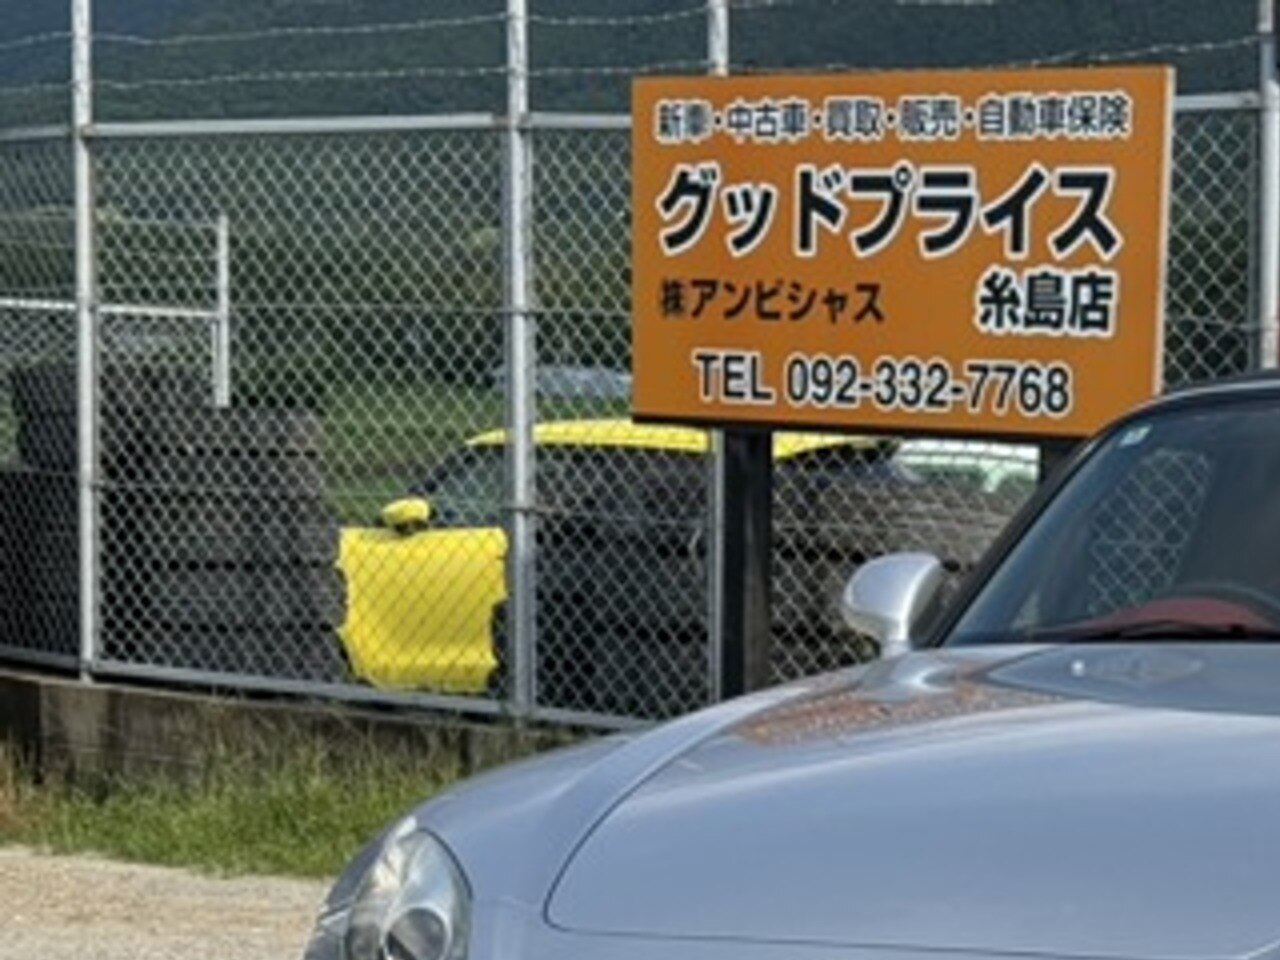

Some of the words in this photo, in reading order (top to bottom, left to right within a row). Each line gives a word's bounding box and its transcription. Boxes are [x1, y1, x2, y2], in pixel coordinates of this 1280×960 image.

[656, 164, 1122, 258] グッドプライス
[977, 268, 1115, 334] 糸島店
[695, 353, 772, 401] TEL
[786, 358, 1070, 415] 092-332-7768
